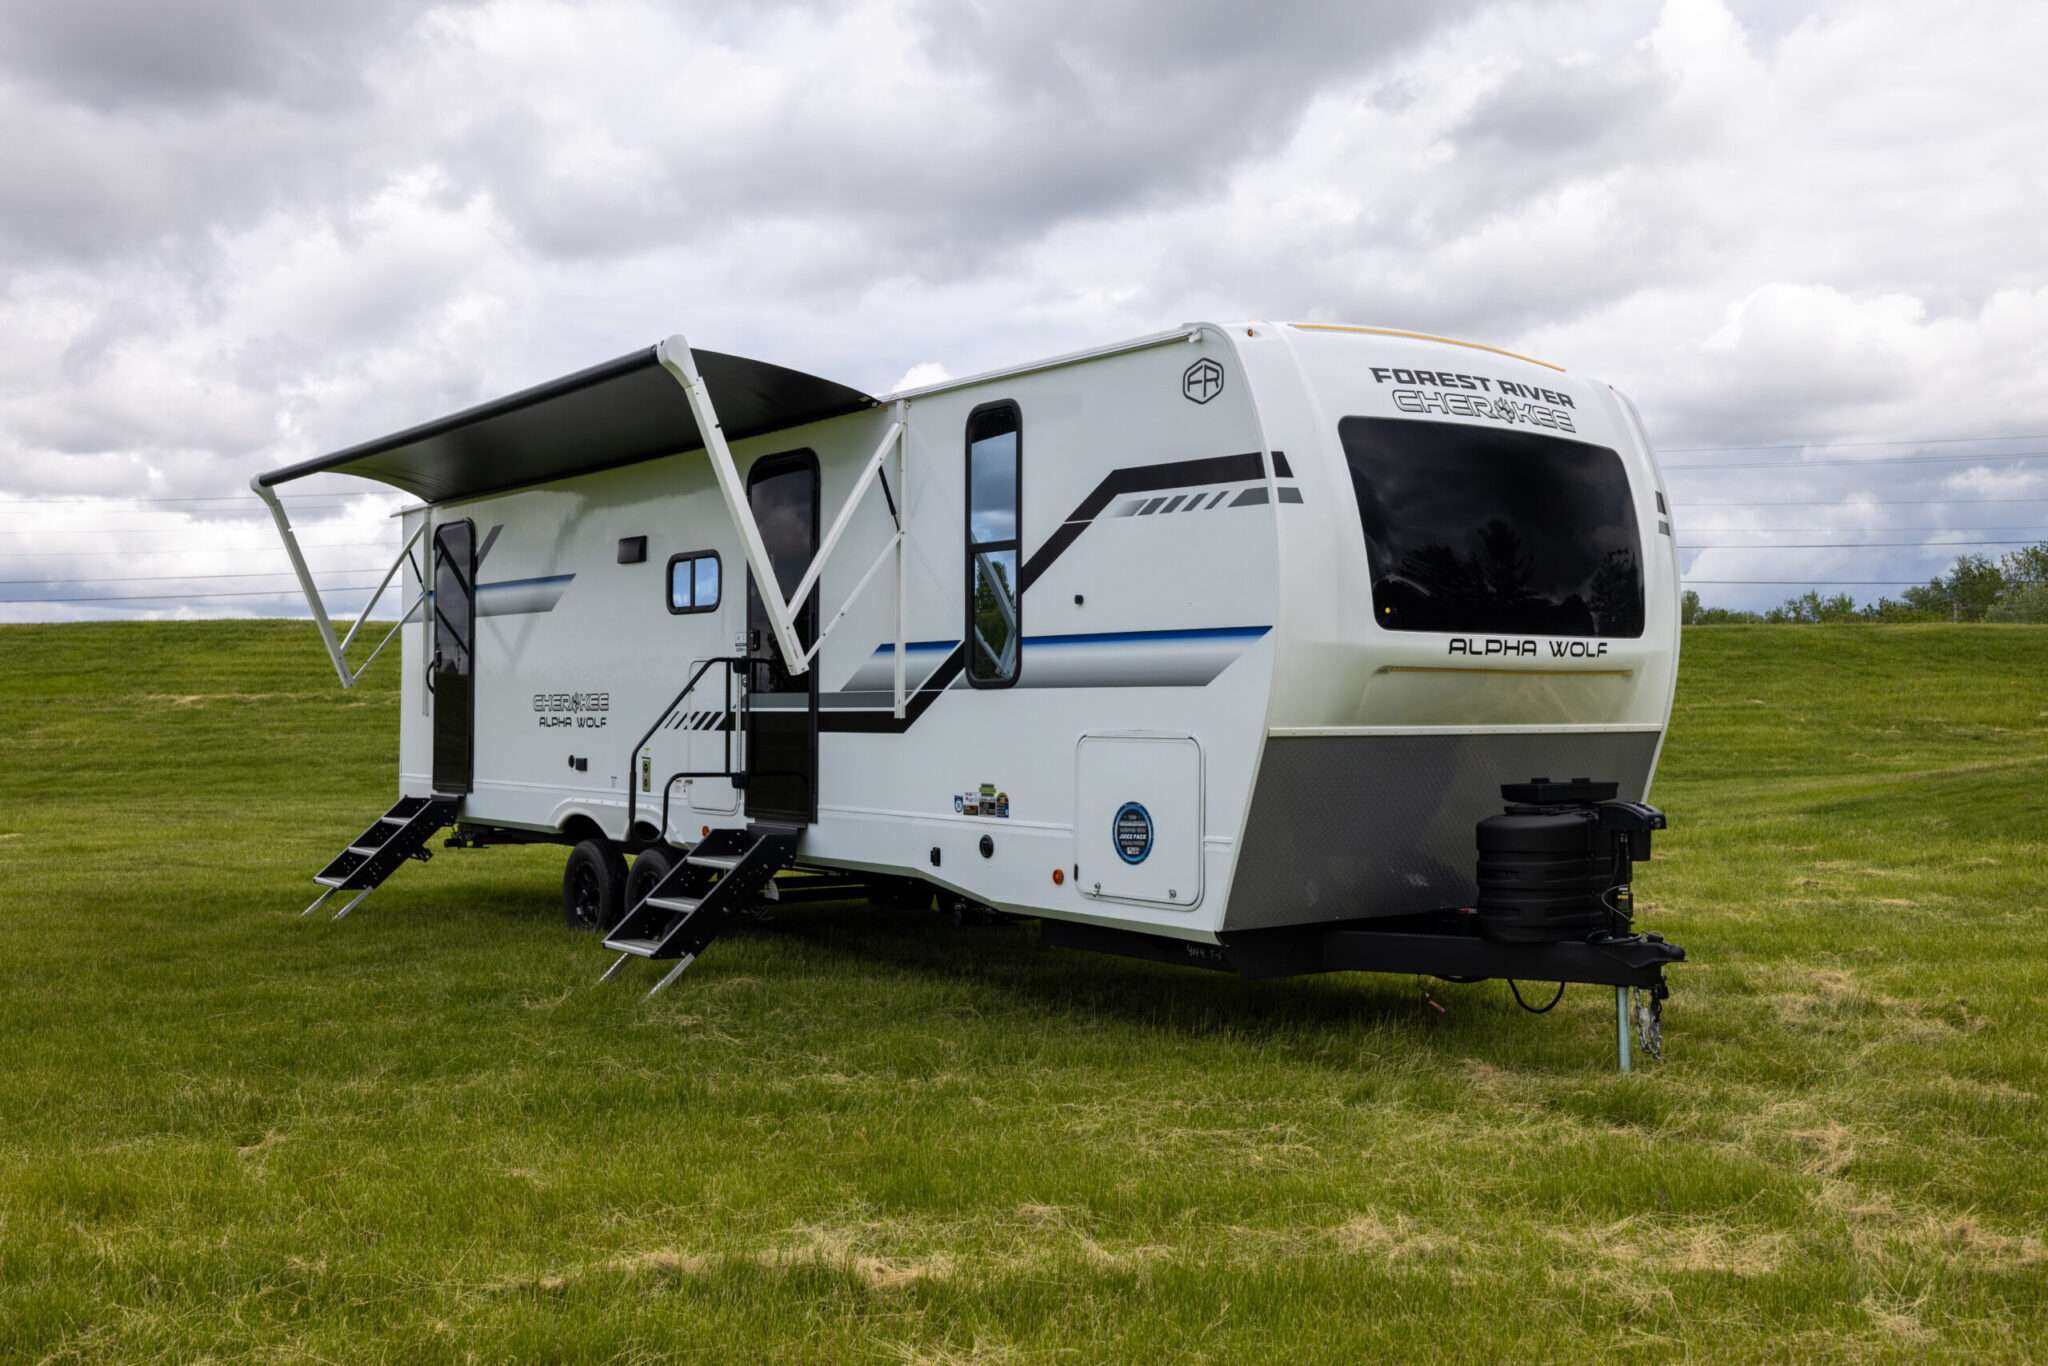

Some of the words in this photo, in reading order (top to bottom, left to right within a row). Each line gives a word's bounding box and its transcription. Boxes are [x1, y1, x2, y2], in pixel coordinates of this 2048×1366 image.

[1369, 367, 1491, 391] FOREST
[1496, 379, 1576, 409] RIVER
[1448, 638, 1537, 656] ALPHA
[1549, 641, 1608, 657] WOLF
[539, 717, 572, 728] ALPHA
[577, 717, 607, 728] WOLF
